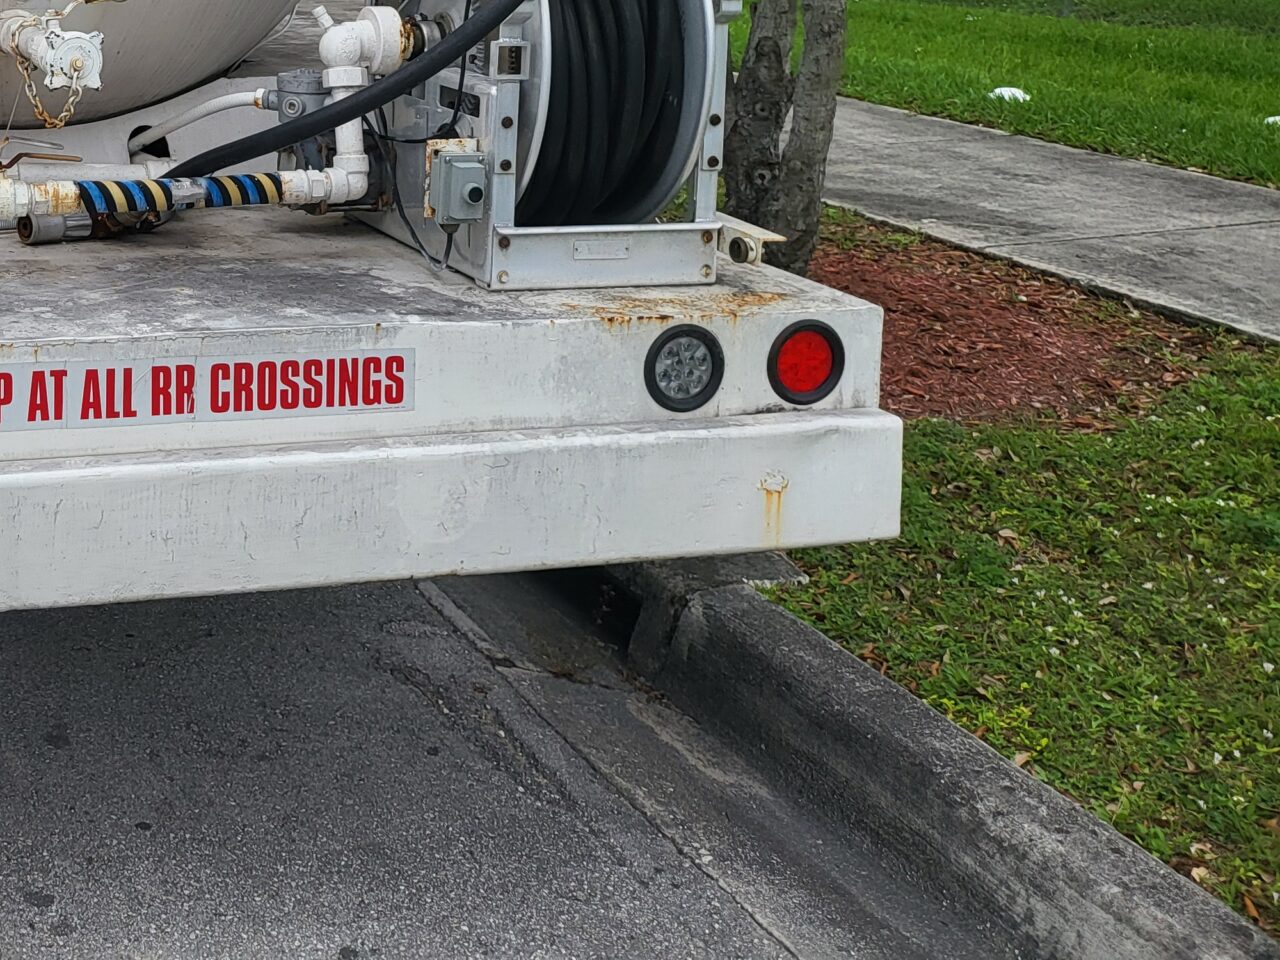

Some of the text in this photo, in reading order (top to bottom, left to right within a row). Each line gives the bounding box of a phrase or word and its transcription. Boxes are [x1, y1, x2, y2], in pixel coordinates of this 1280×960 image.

[27, 369, 68, 422] AT
[80, 367, 138, 420] ALL
[151, 364, 196, 417] RR
[210, 355, 405, 414] CROSSINGS
